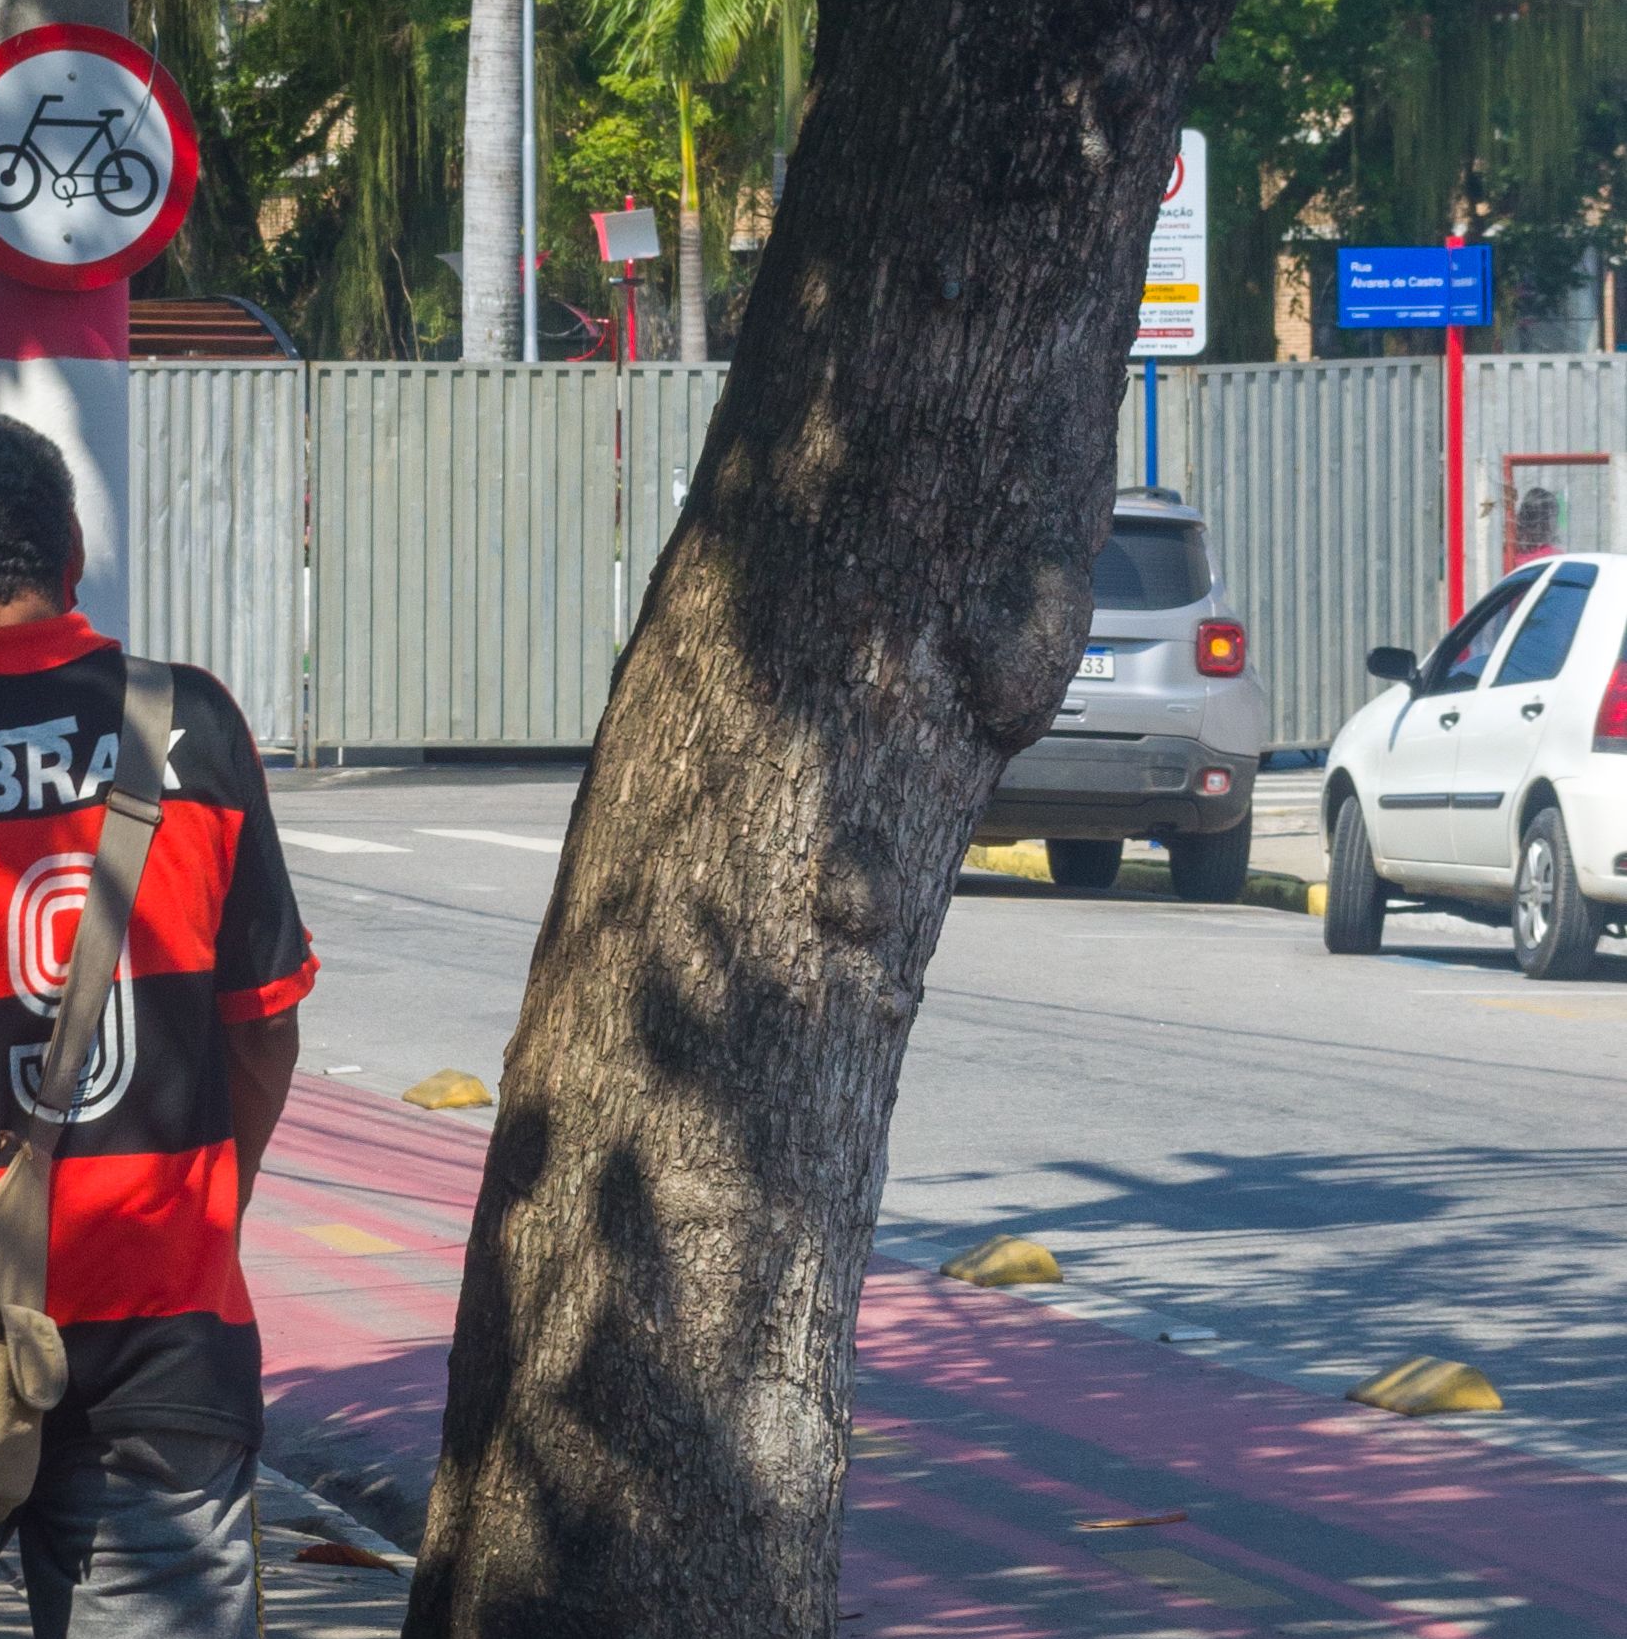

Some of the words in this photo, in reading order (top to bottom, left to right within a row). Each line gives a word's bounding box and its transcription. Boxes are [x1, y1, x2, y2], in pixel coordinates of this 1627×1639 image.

[1159, 207, 1193, 219] RAÇÃO
[1350, 262, 1373, 272] Rua
[1408, 276, 1444, 288] Castro
[1079, 657, 1104, 674] 33
